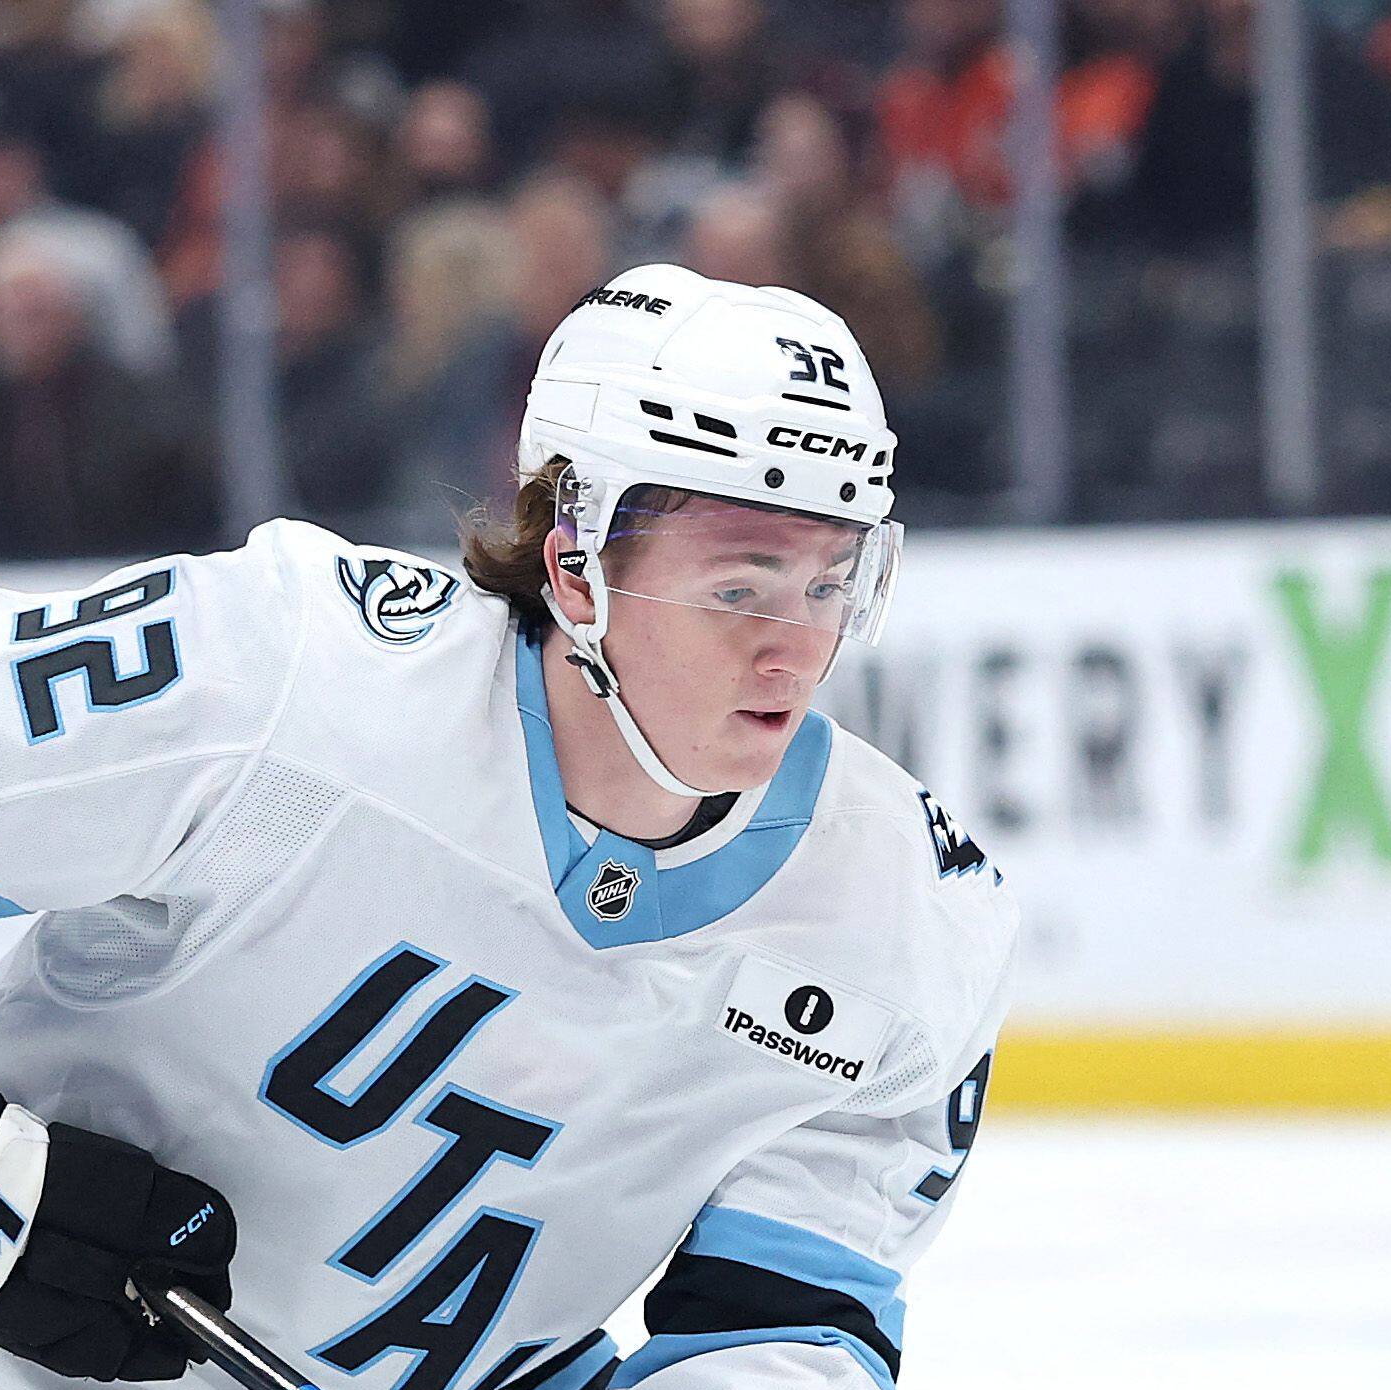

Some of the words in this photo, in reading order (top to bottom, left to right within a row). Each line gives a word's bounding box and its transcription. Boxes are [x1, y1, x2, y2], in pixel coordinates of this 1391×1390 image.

[766, 426, 868, 462] CCM
[560, 555, 586, 566] CCM
[10, 566, 184, 746] 92
[595, 881, 629, 903] NHL
[722, 1006, 865, 1083] 1Password
[169, 1202, 215, 1246] CCM
